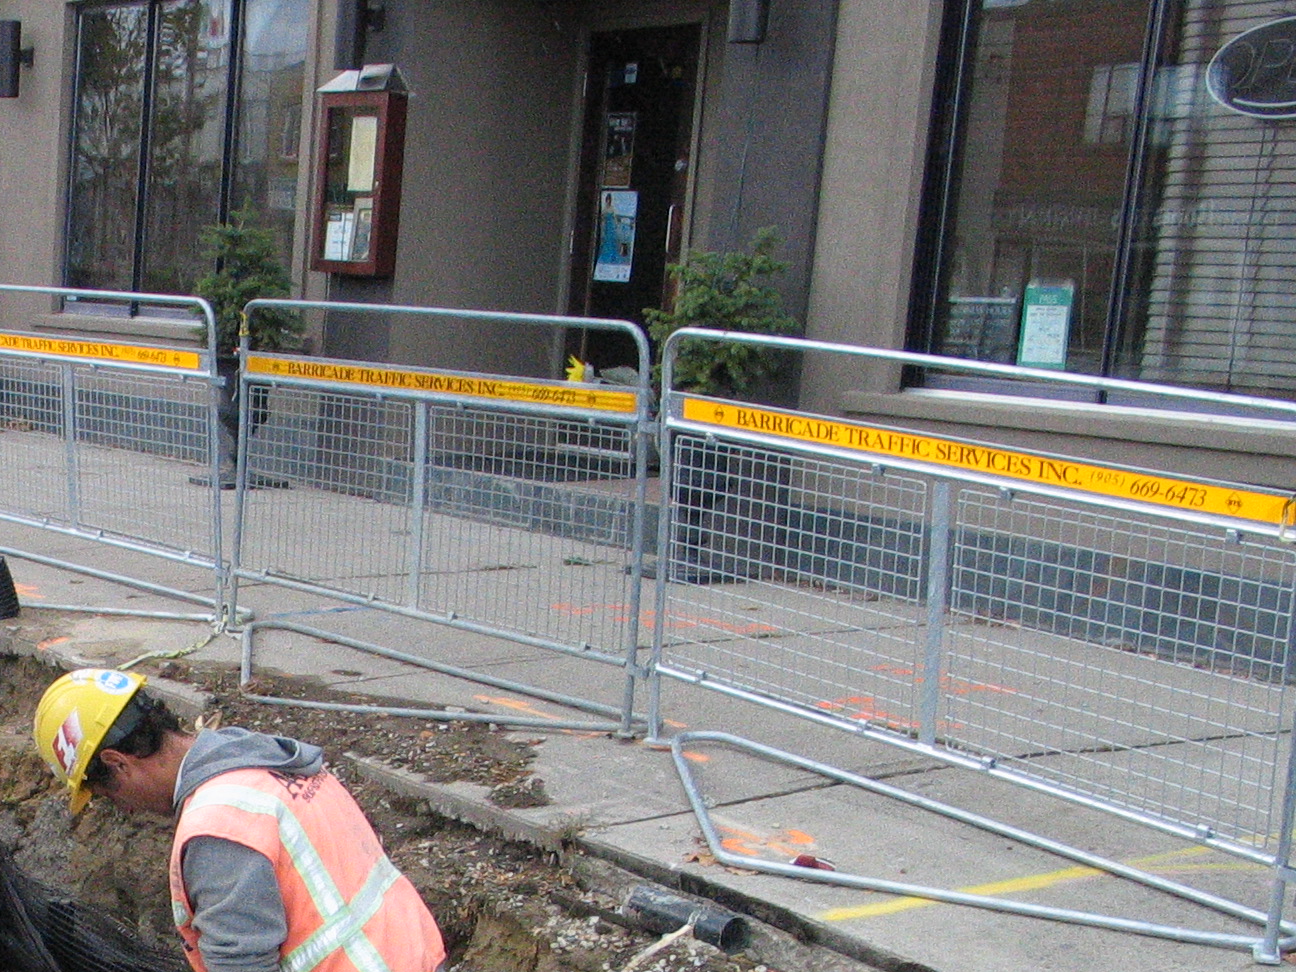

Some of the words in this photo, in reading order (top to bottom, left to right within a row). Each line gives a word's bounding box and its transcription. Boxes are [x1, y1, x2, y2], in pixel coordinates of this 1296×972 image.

[20, 338, 55, 350] TRAFFIC
[58, 341, 99, 356] SERVICES
[288, 362, 355, 381] BARRICADE
[358, 369, 413, 387] TRAFFIC
[414, 374, 474, 394] SERVICES
[736, 408, 840, 442] BARRICADE
[844, 427, 931, 458] TRAFFIC
[935, 442, 1031, 476] SERVICES
[1037, 460, 1083, 486] INC.
[1090, 470, 1125, 488] (905)
[1129, 479, 1208, 507] 669-6473
